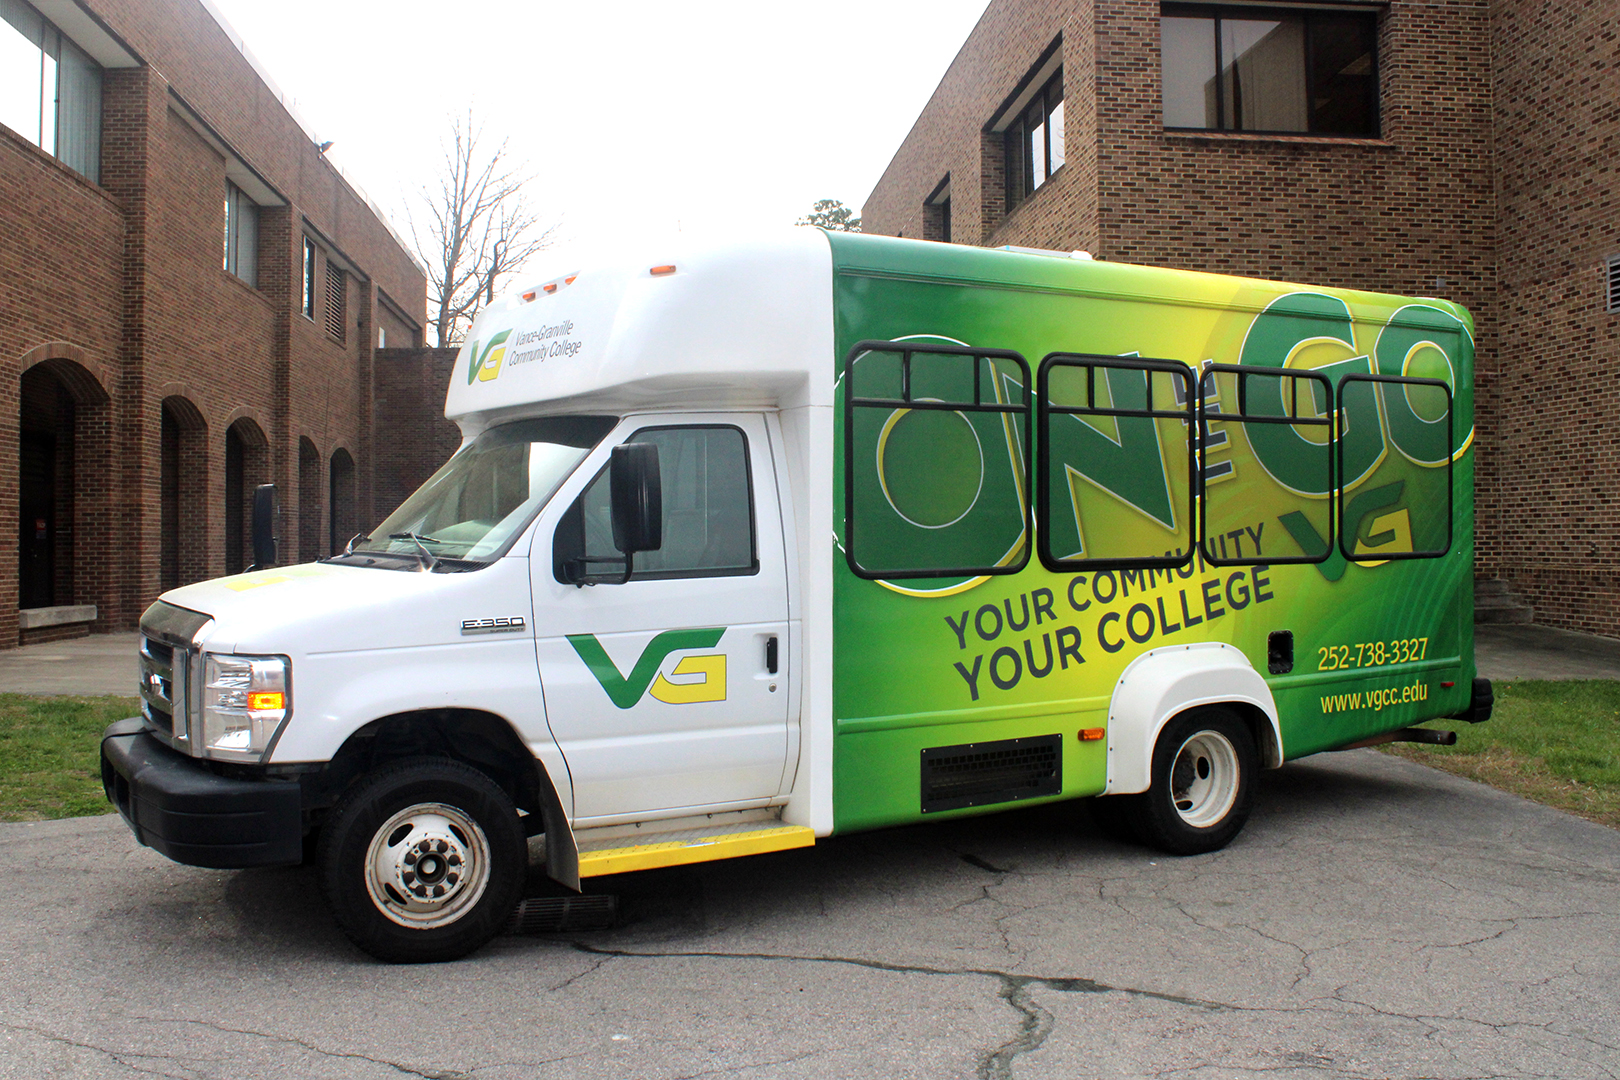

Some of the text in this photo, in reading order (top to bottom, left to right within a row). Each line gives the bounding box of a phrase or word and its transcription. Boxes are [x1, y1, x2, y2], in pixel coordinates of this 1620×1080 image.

[515, 320, 574, 346] Vance-Granville
[508, 340, 582, 367] Community College
[1235, 291, 1475, 497] GO
[944, 522, 1265, 650] YOUR COMMUNITY
[953, 565, 1275, 702] YOUR COLLEGE
[1318, 637, 1429, 671] 252-738-3327
[1320, 680, 1428, 714] www.vgcc.edu
